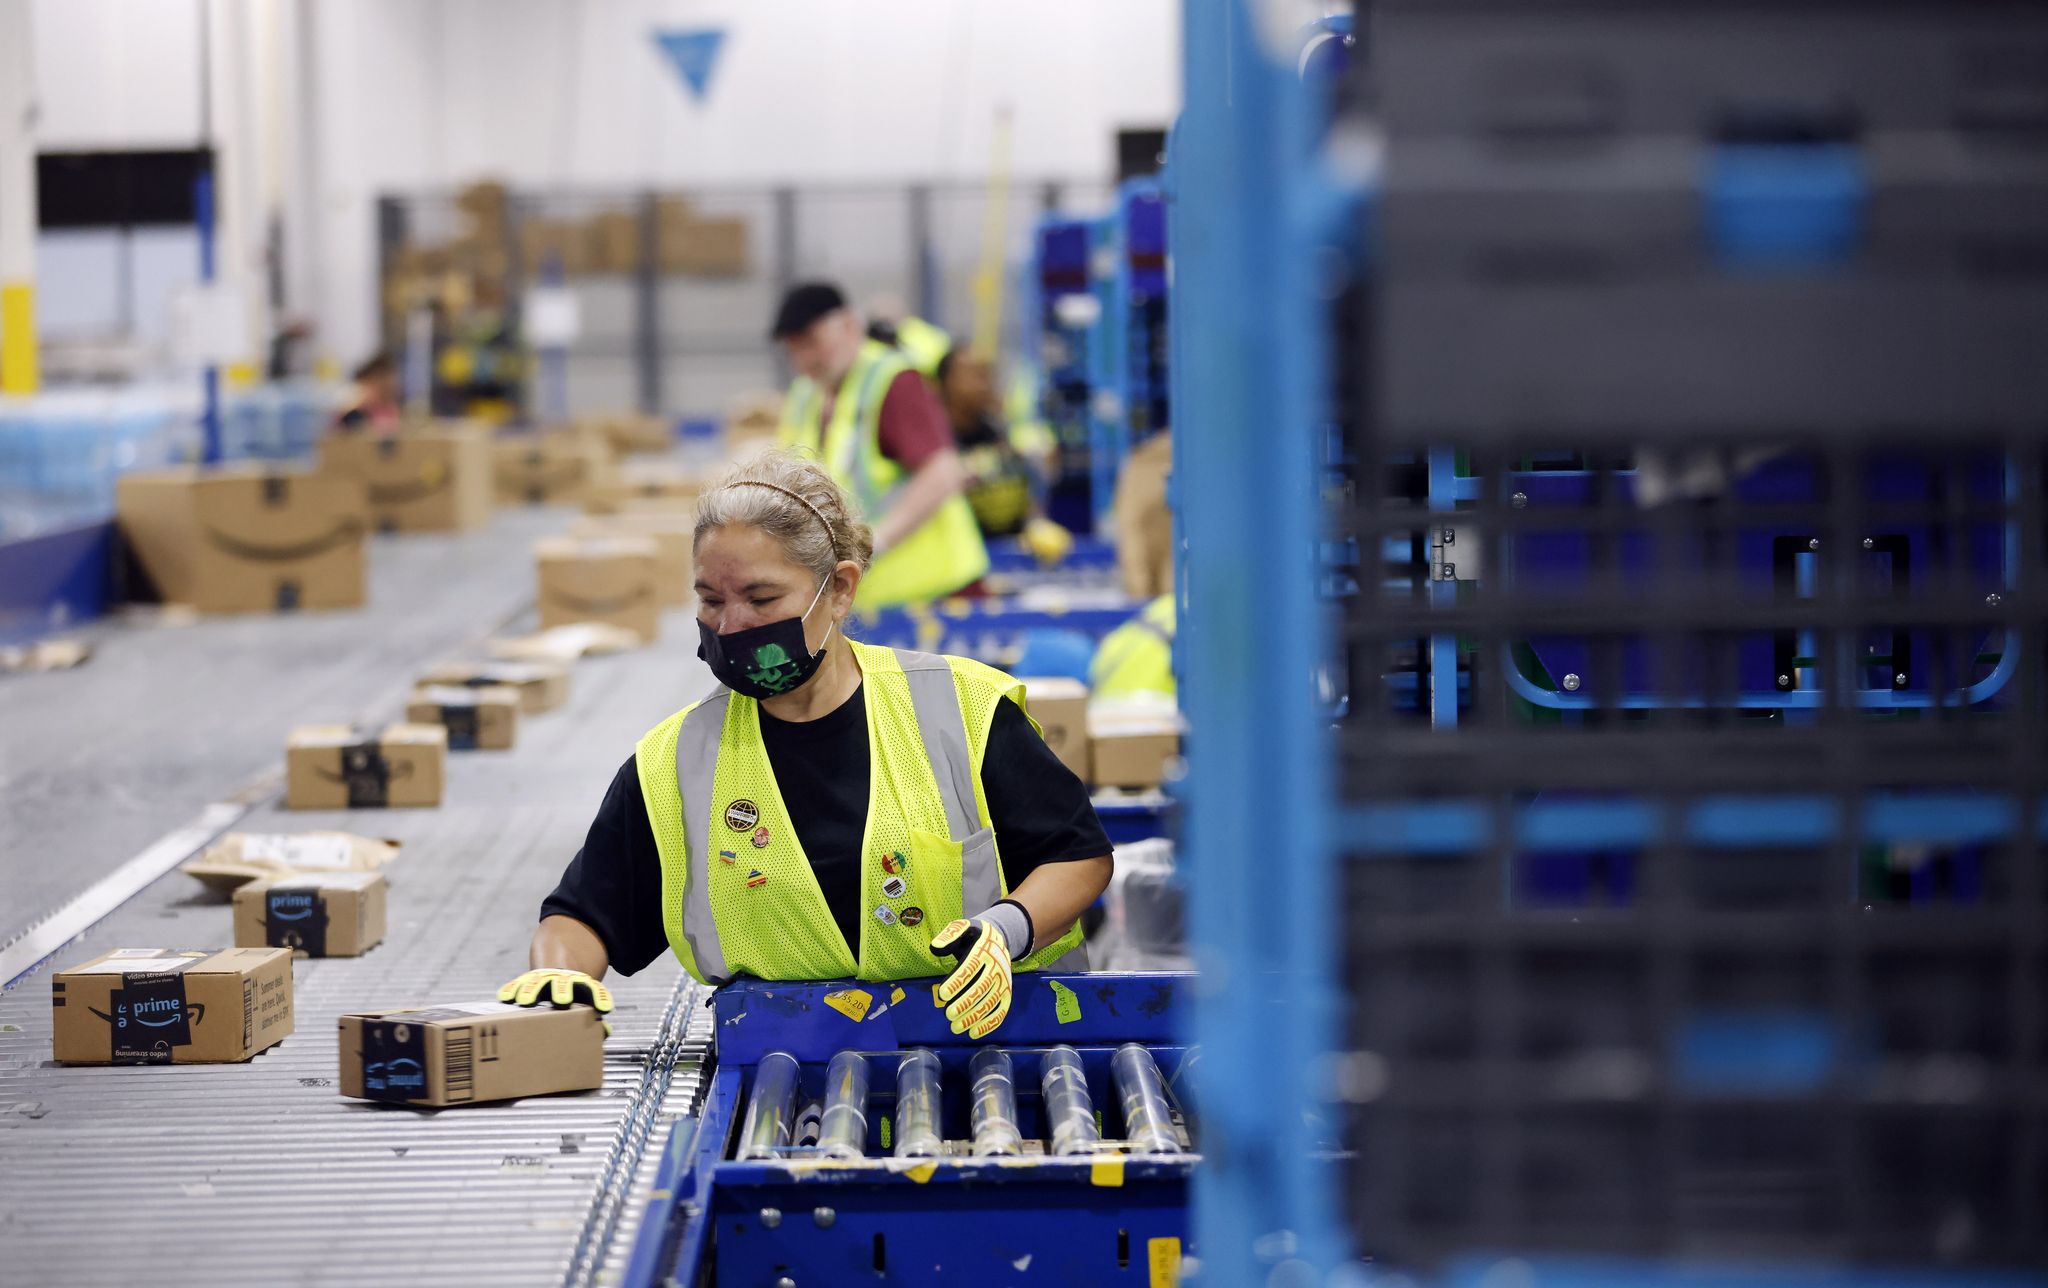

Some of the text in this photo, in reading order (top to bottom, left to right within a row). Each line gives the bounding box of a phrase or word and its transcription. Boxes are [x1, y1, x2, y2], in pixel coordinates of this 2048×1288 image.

[270, 893, 312, 910] prime
[127, 972, 146, 980] video
[133, 997, 180, 1017] prime
[115, 1049, 168, 1059] video streaming
